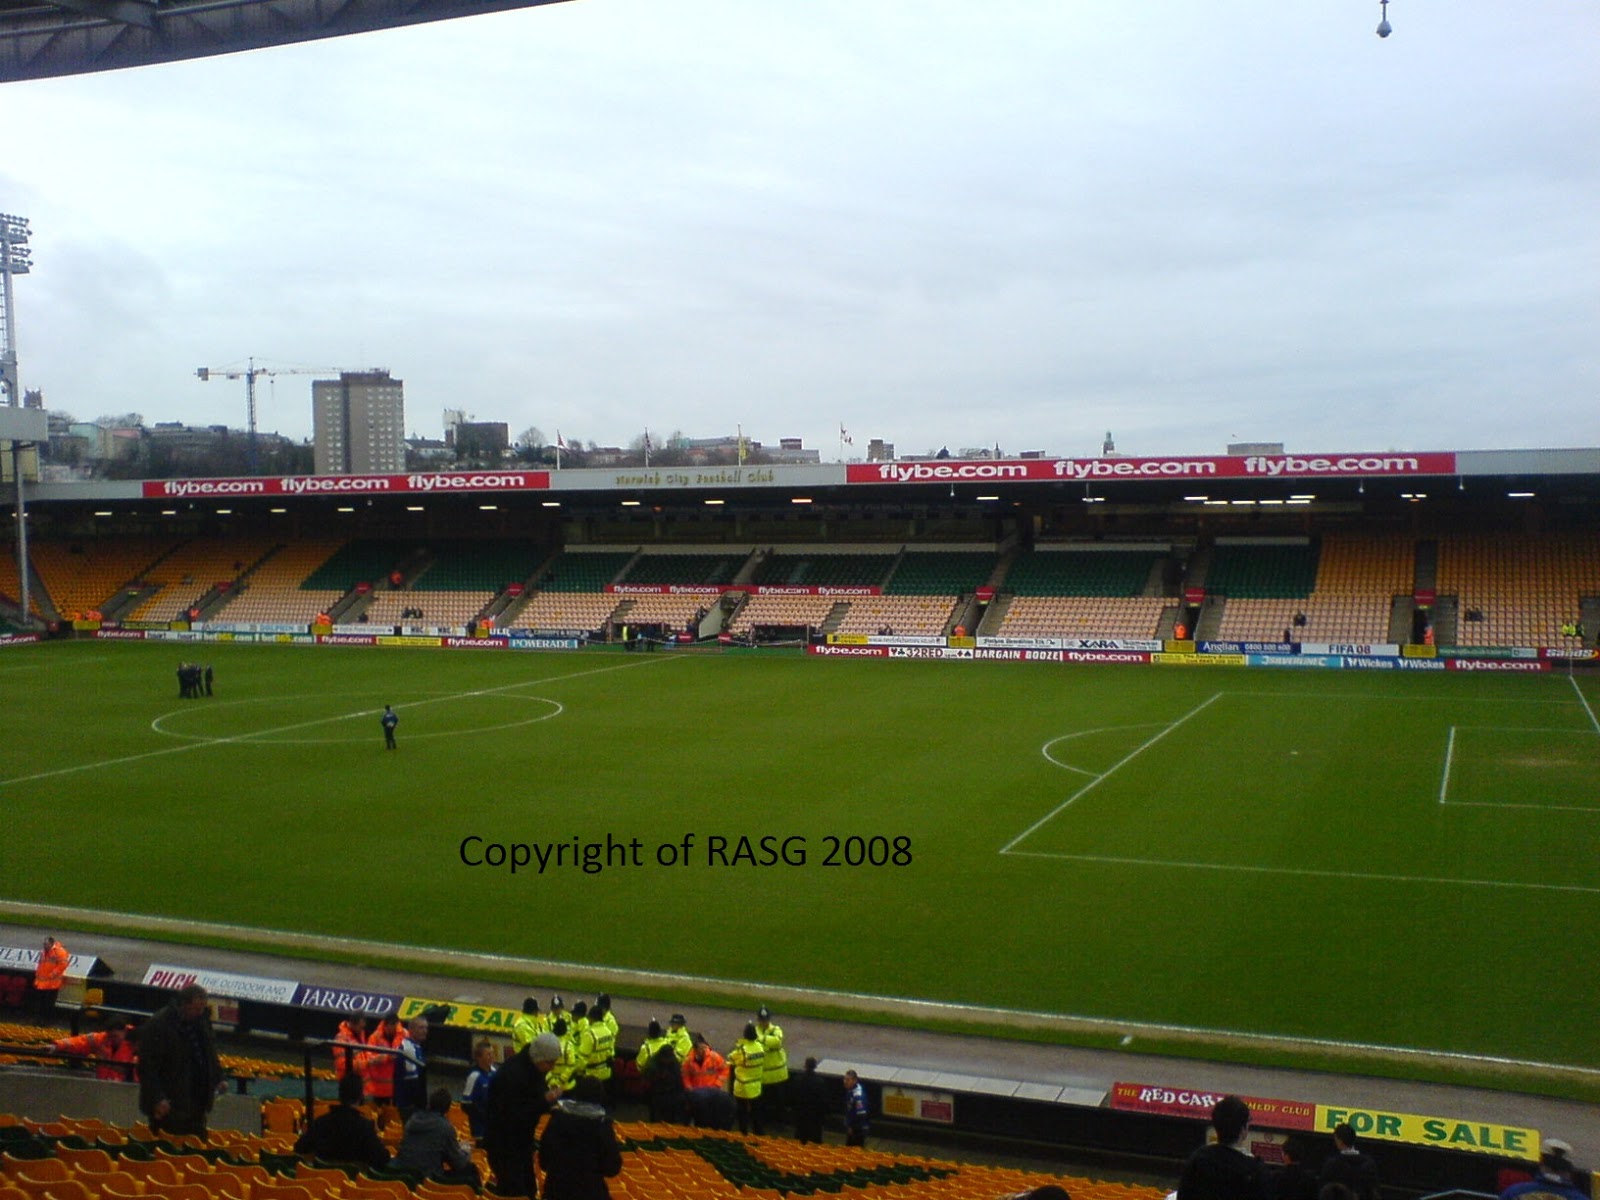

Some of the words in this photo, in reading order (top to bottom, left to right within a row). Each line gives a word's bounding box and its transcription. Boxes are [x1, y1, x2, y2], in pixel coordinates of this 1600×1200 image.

[878, 463, 1027, 481] flybe.com
[1053, 460, 1216, 478] flybe.com
[1244, 456, 1418, 475] flybe.com
[164, 480, 263, 496] flybe.com
[280, 477, 389, 493] flybe.com
[408, 473, 525, 490] flybe.com
[613, 585, 662, 594] flybe.com
[669, 586, 719, 594] flybe.com
[758, 586, 810, 595] flybe.com
[818, 587, 871, 596] flybe.com
[322, 635, 372, 644] flybe.com
[447, 638, 503, 647] flybe.com
[815, 645, 883, 656] flybe.com
[907, 648, 943, 658] 32RED
[1329, 645, 1354, 654] FIFA
[1356, 645, 1371, 654] 08
[975, 650, 1020, 660] BARGAIN
[1025, 650, 1059, 660] BOOZE
[1068, 652, 1143, 662] flybe.com
[1409, 659, 1445, 669] Wickes
[1455, 659, 1541, 670] flybe.com
[301, 988, 392, 1013] JARROLD
[469, 1008, 515, 1028] SAL
[1117, 1088, 1137, 1097] THE
[1138, 1088, 1175, 1104] RED
[1178, 1092, 1224, 1108] CAR
[1244, 1101, 1278, 1112] MEDY
[1281, 1105, 1310, 1116] CLUB
[1326, 1108, 1402, 1136] FOR
[1423, 1119, 1527, 1153] SALE
